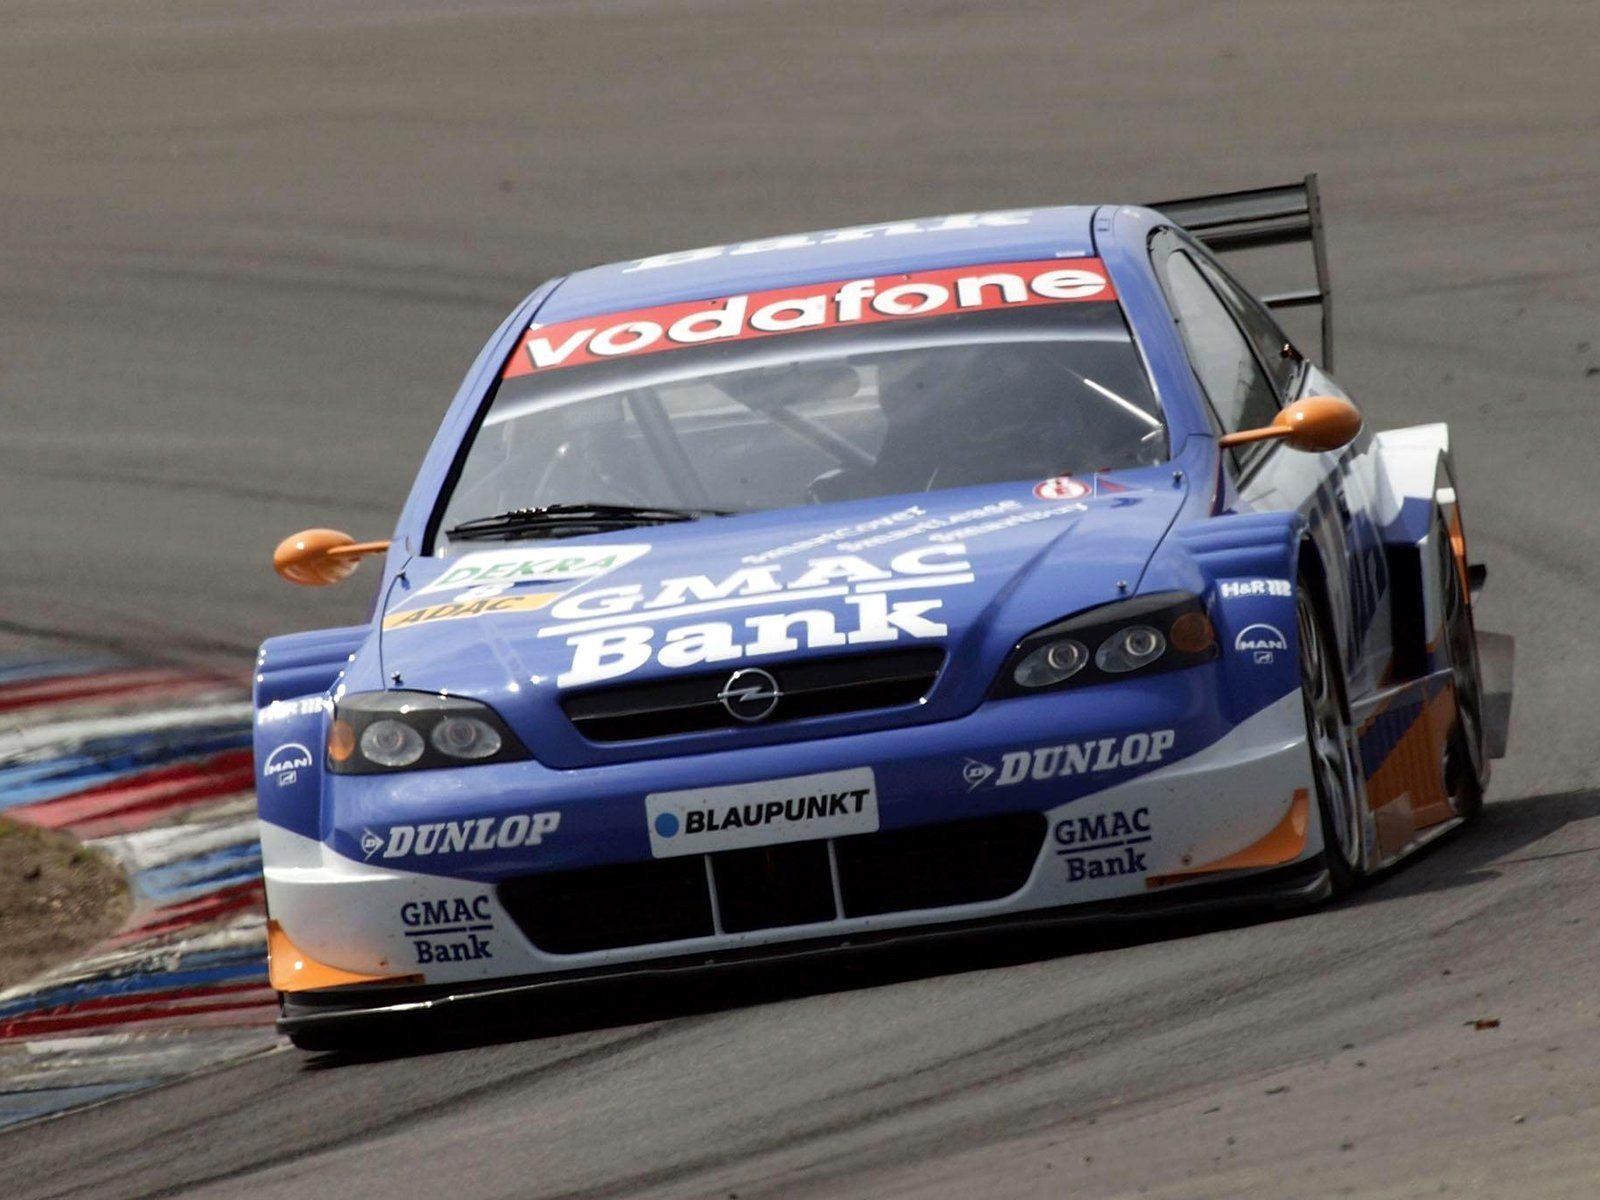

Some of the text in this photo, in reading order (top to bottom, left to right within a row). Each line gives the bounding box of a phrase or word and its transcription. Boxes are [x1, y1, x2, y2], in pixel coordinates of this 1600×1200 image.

[529, 268, 1107, 369] vodafone
[437, 554, 618, 586] DEKRA
[551, 543, 971, 619] GMAC
[394, 597, 526, 628] ADAC
[557, 592, 948, 689] Bank
[1240, 640, 1283, 651] MAN
[267, 757, 308, 775] MAN
[995, 729, 1176, 786] DUNLOP
[685, 789, 870, 834] BLAUPUNKT
[1055, 807, 1151, 845] GMAC
[382, 811, 561, 858] DUNLOP
[1064, 848, 1148, 882] Bank
[401, 895, 492, 926] GMAC
[414, 934, 493, 964] Bank
